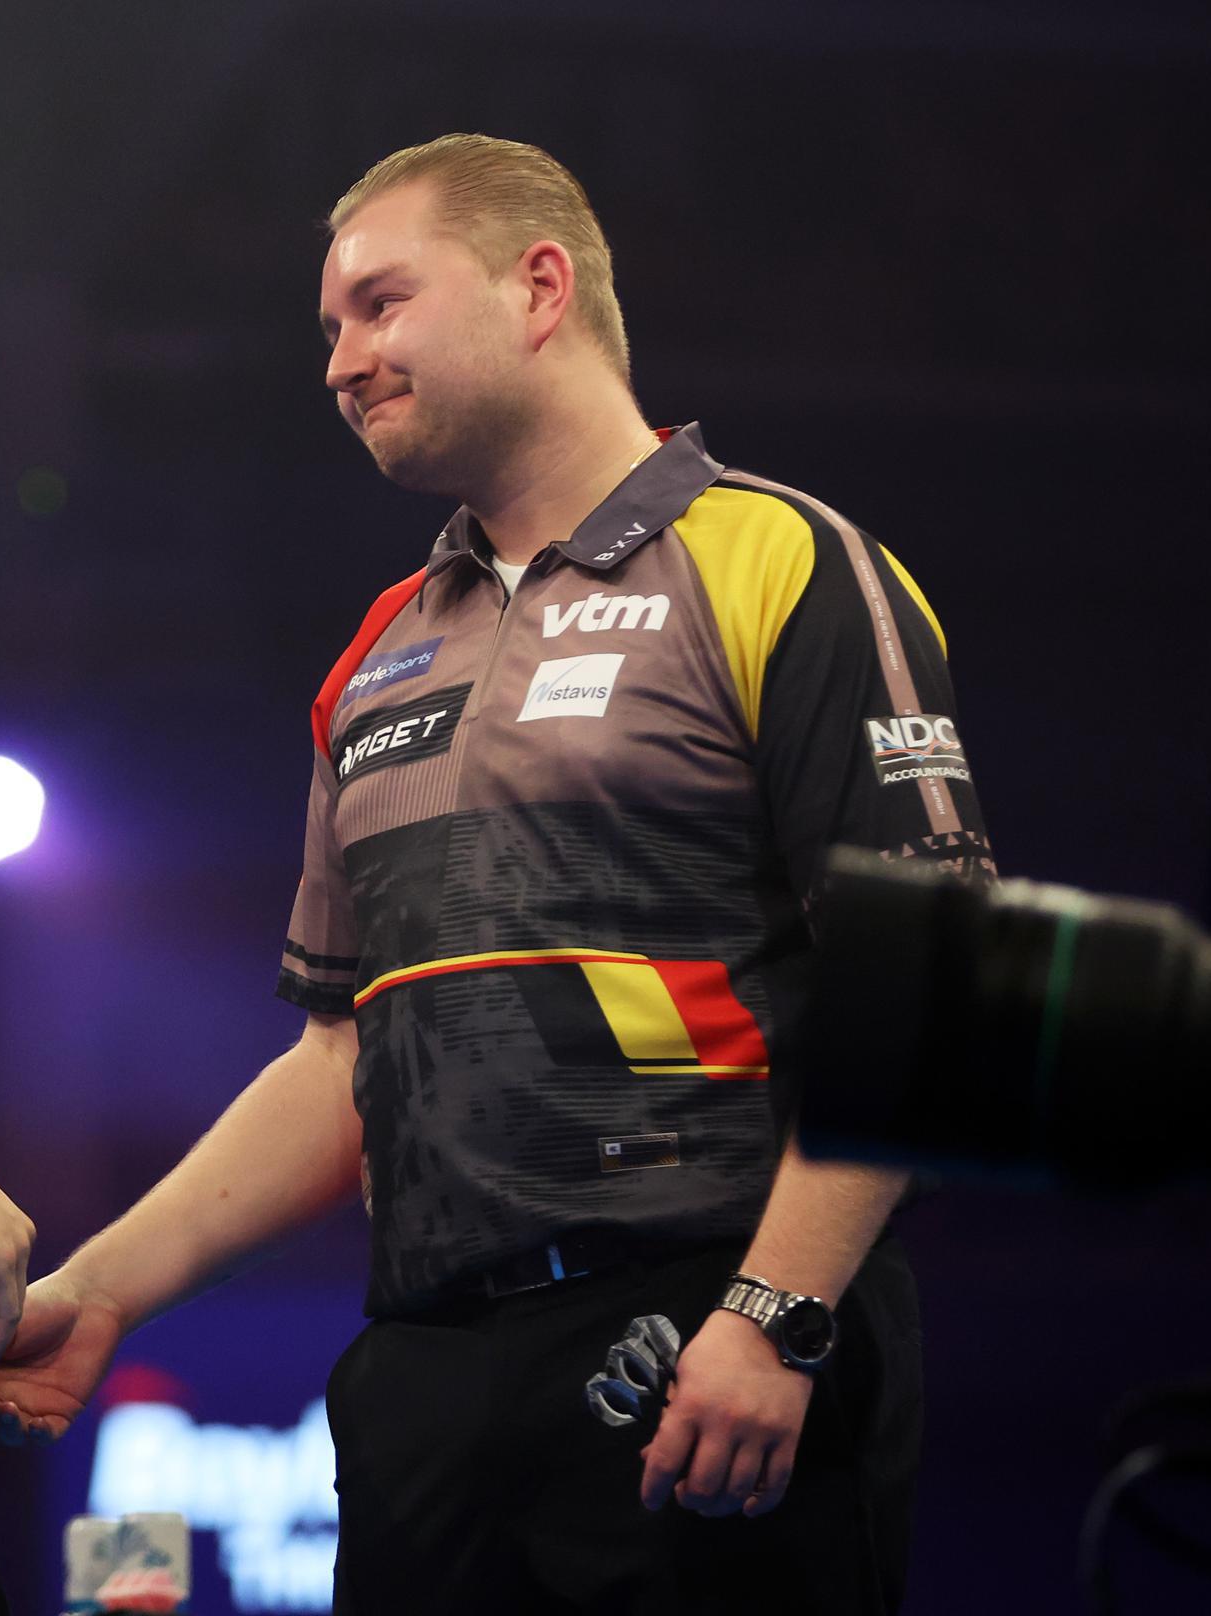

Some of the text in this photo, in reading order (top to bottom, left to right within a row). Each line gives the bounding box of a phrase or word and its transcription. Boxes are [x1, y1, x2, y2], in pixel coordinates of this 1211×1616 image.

[542, 592, 670, 638] vtm
[347, 650, 434, 692] BoyleSports
[339, 710, 447, 779] ARGET
[867, 717, 961, 753] NDC
